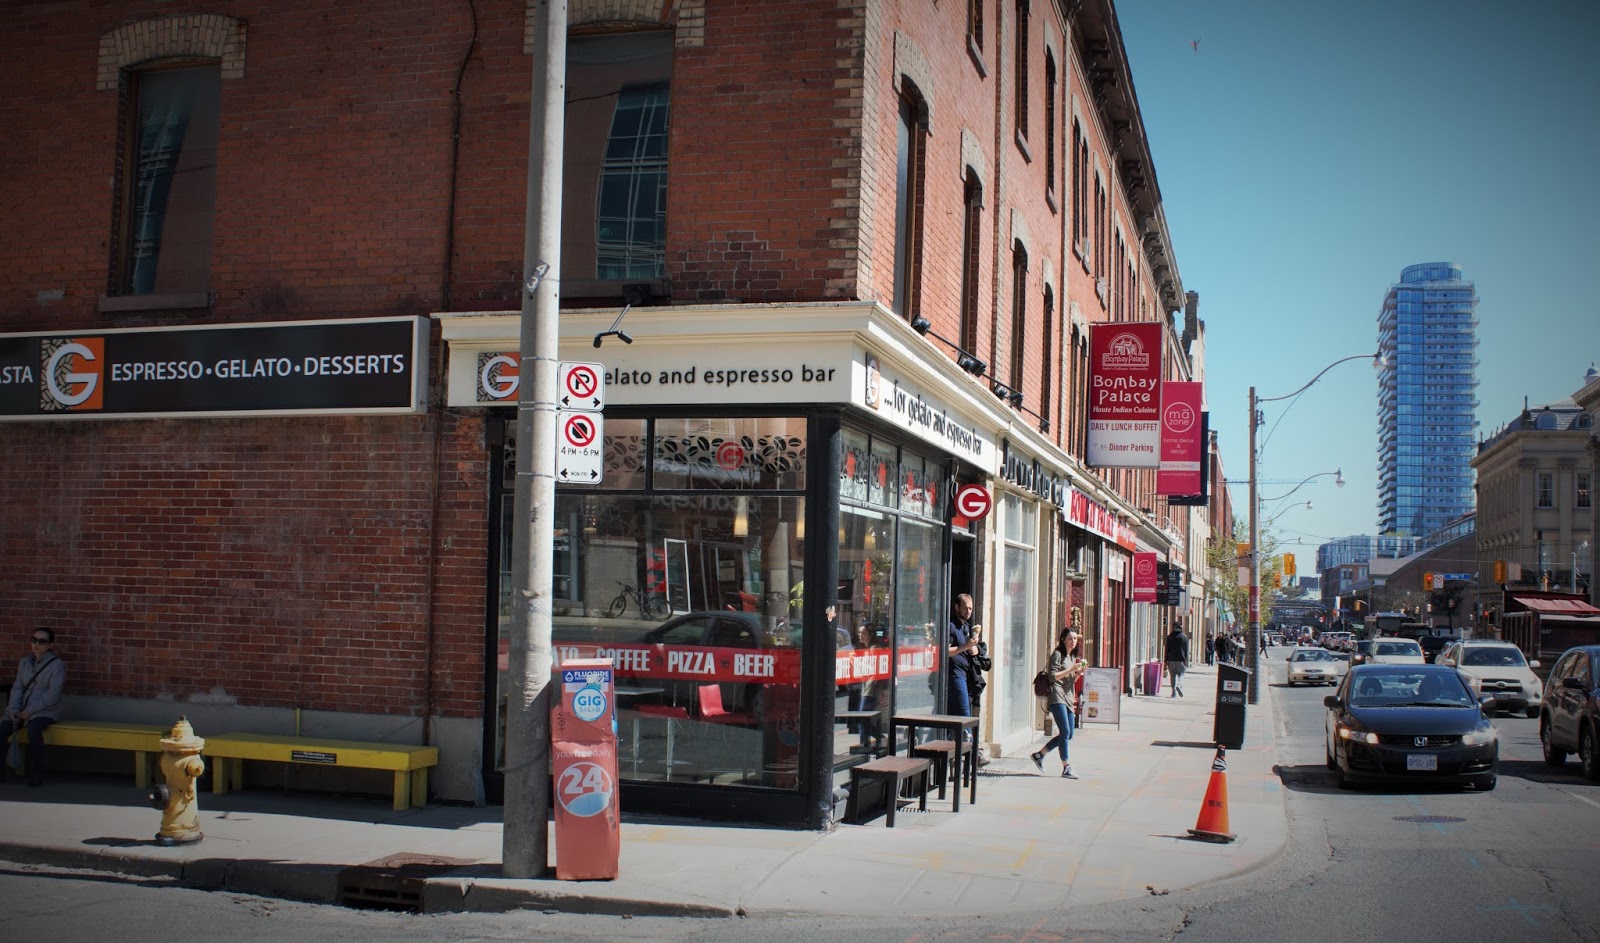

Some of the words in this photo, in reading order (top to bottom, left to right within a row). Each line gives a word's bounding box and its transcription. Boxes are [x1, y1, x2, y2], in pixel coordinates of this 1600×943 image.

[0, 366, 34, 384] STA
[111, 360, 204, 382] ESPRESSO
[214, 357, 292, 379] GELATO
[303, 354, 404, 377] DESSERTS
[604, 366, 651, 385] elato
[659, 366, 696, 385] and
[704, 368, 793, 388] espresso
[801, 364, 836, 383] bar
[1093, 375, 1157, 391] Bombay
[1099, 389, 1151, 405] Palace
[1090, 422, 1110, 431] DAILY
[1111, 422, 1132, 431] LUNCH
[1134, 423, 1158, 431] BUFFET
[561, 446, 566, 455] 4
[567, 448, 577, 456] PM
[583, 447, 589, 456] 6
[1109, 443, 1129, 452] Dinner
[1130, 443, 1154, 453] Parking
[552, 646, 579, 668] ATO
[667, 650, 716, 675] PIZZA
[733, 653, 774, 677] BEER
[577, 696, 601, 706] GIG
[1228, 695, 1242, 703] Litter
[564, 767, 603, 794] 24
